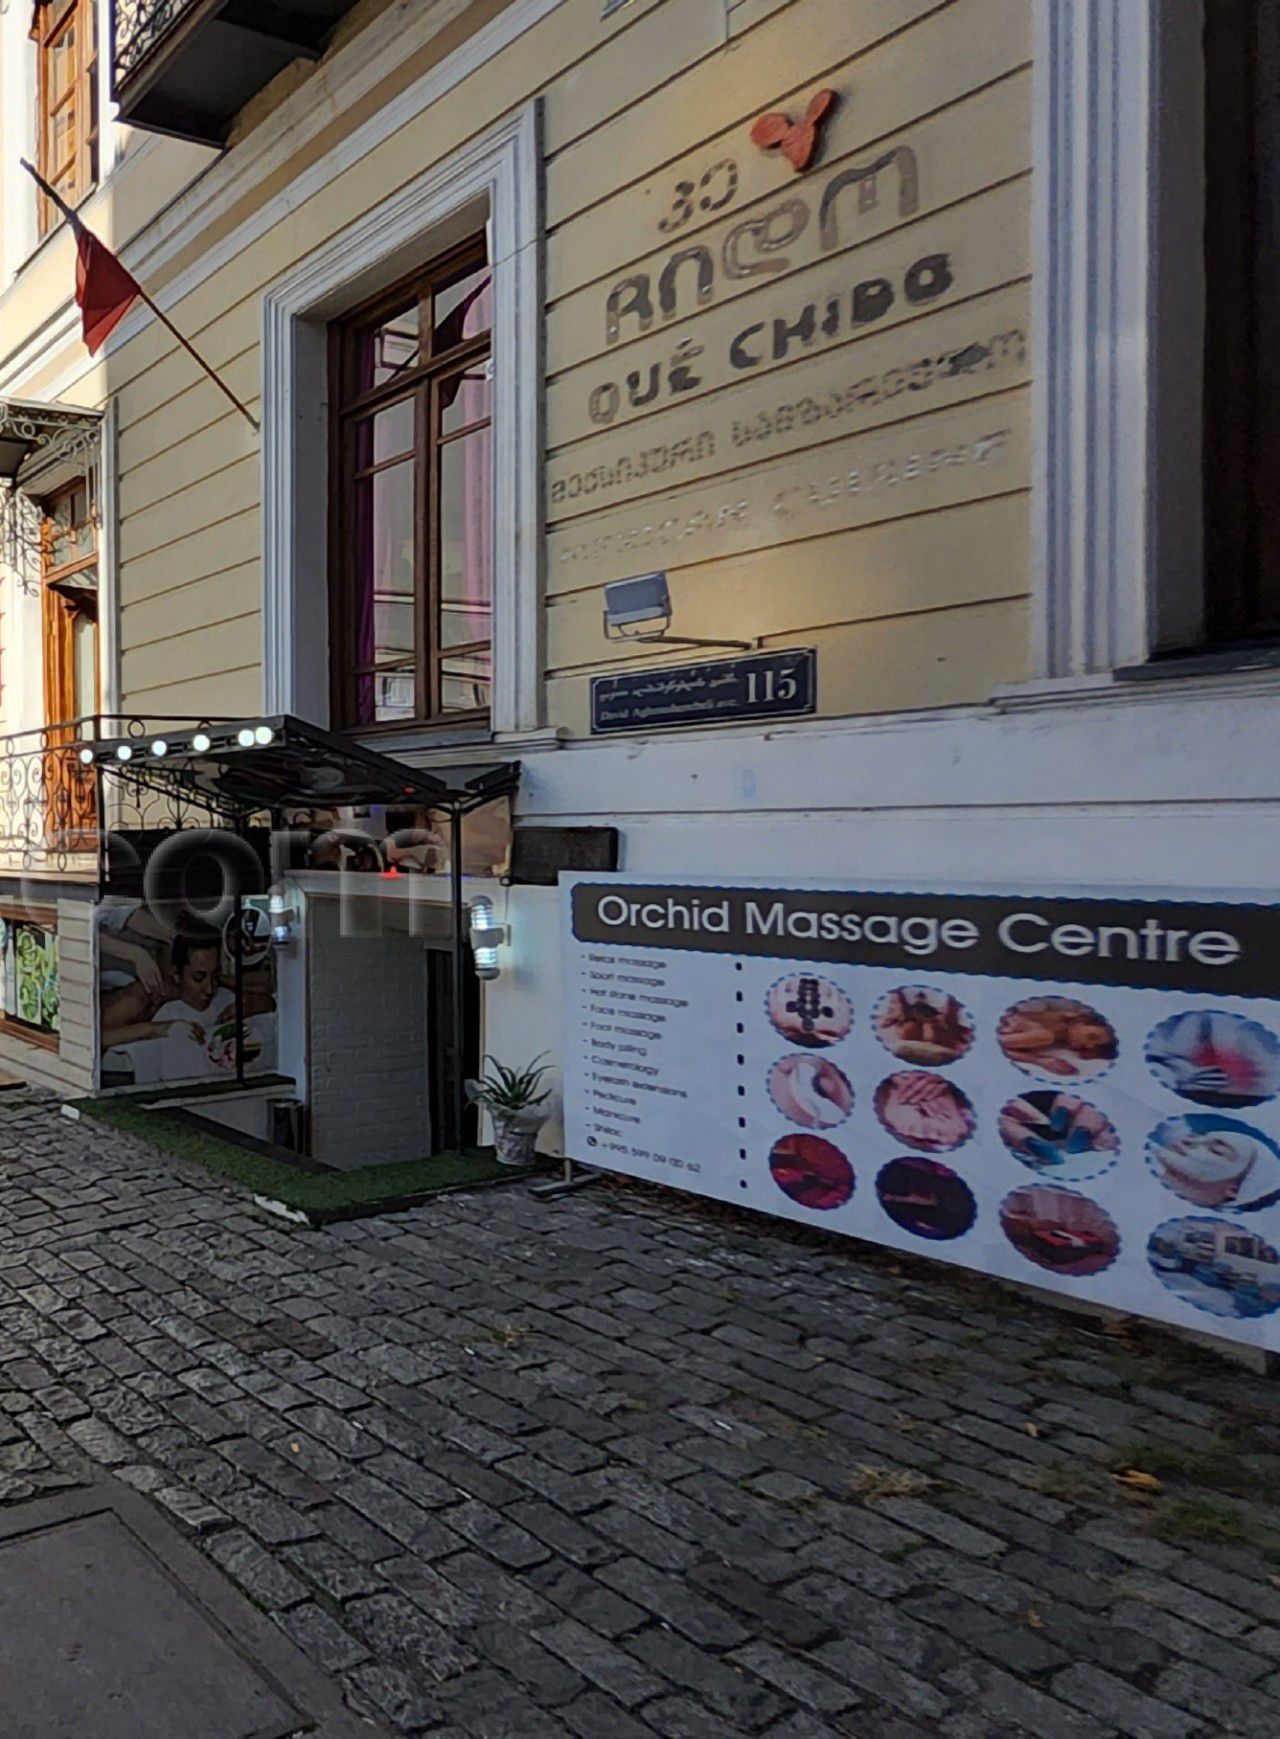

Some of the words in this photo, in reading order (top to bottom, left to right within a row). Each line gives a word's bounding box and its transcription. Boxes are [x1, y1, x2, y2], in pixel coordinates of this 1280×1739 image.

[729, 252, 956, 370] CHIDO
[746, 667, 798, 704] 115
[597, 895, 730, 933] Orchid
[745, 901, 980, 956] Massage
[998, 912, 1242, 966] Centre
[618, 957, 667, 970] massage
[617, 974, 665, 988] massage
[639, 994, 688, 1009] massage
[618, 1009, 667, 1024] massage
[614, 1025, 663, 1041] massage
